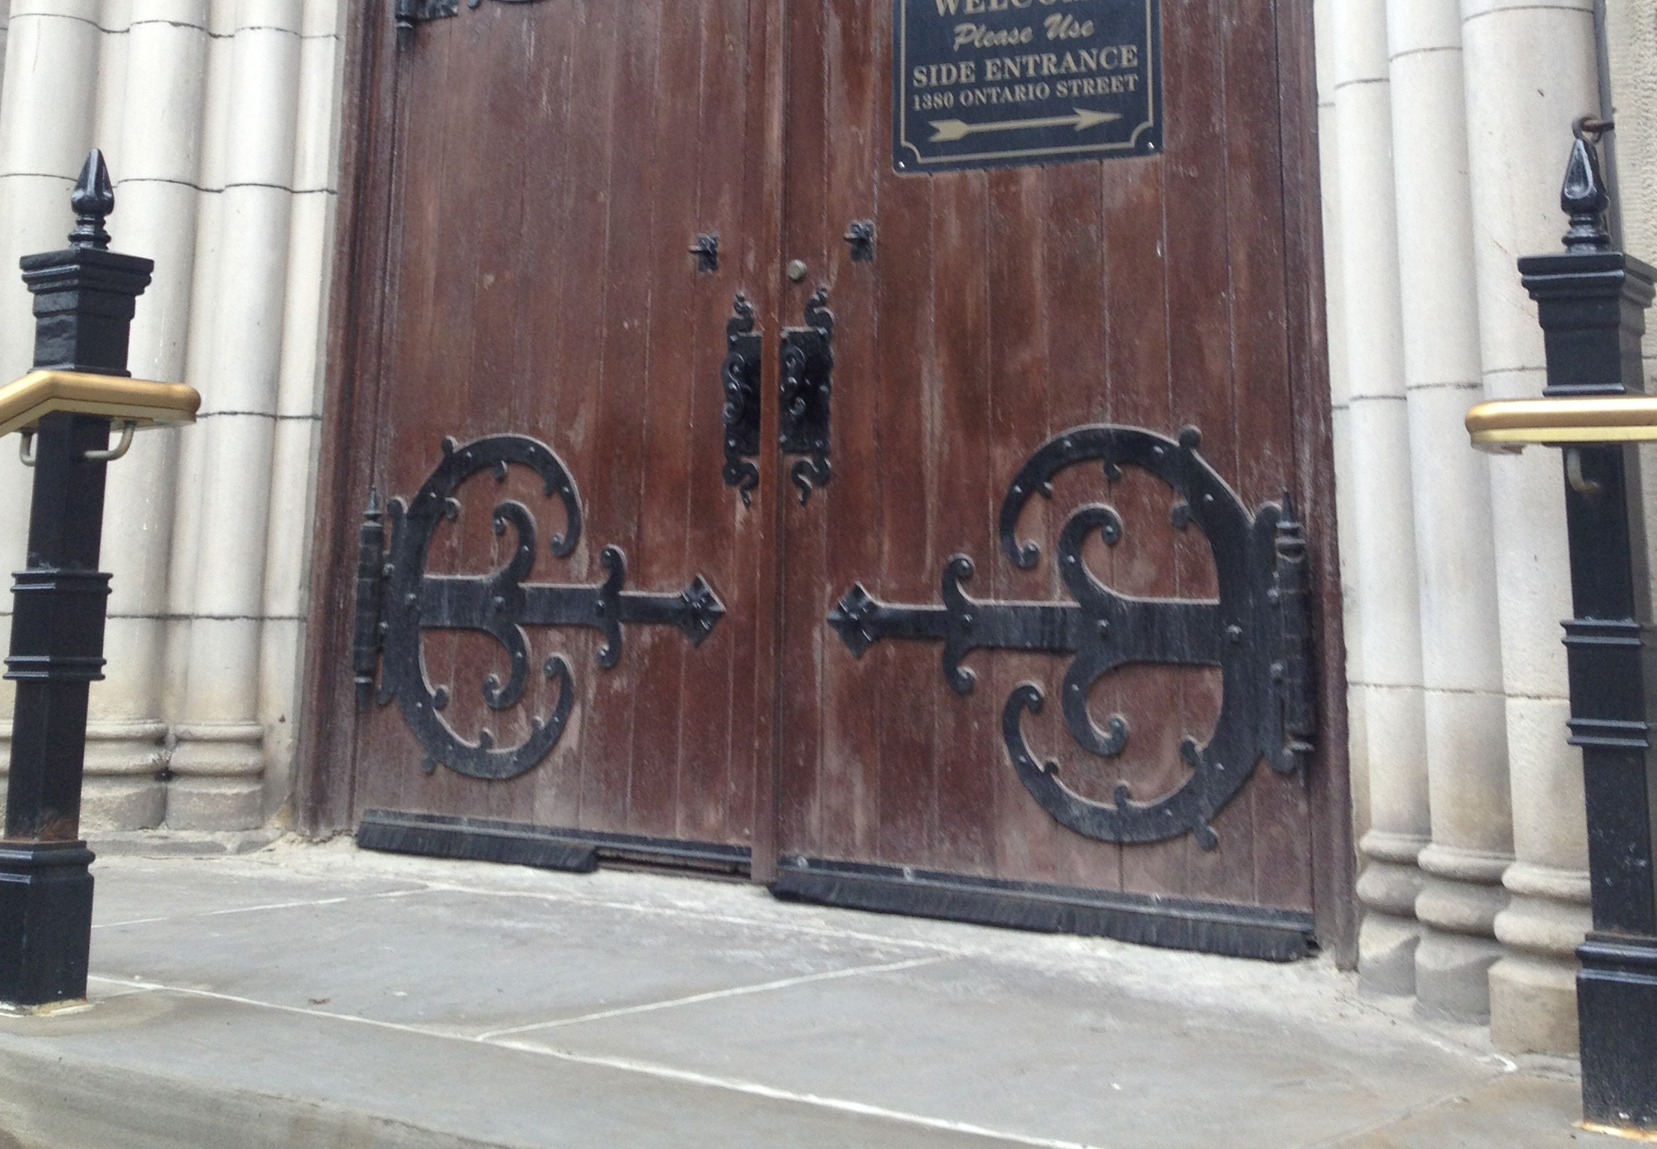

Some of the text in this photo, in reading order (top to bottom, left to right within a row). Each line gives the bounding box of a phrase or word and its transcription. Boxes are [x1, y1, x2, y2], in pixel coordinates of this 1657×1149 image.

[953, 12, 1095, 51] Please Use
[912, 44, 1139, 88] SIDE ENTRANCE
[913, 73, 1139, 112] 1380 ONTARIO STREET
